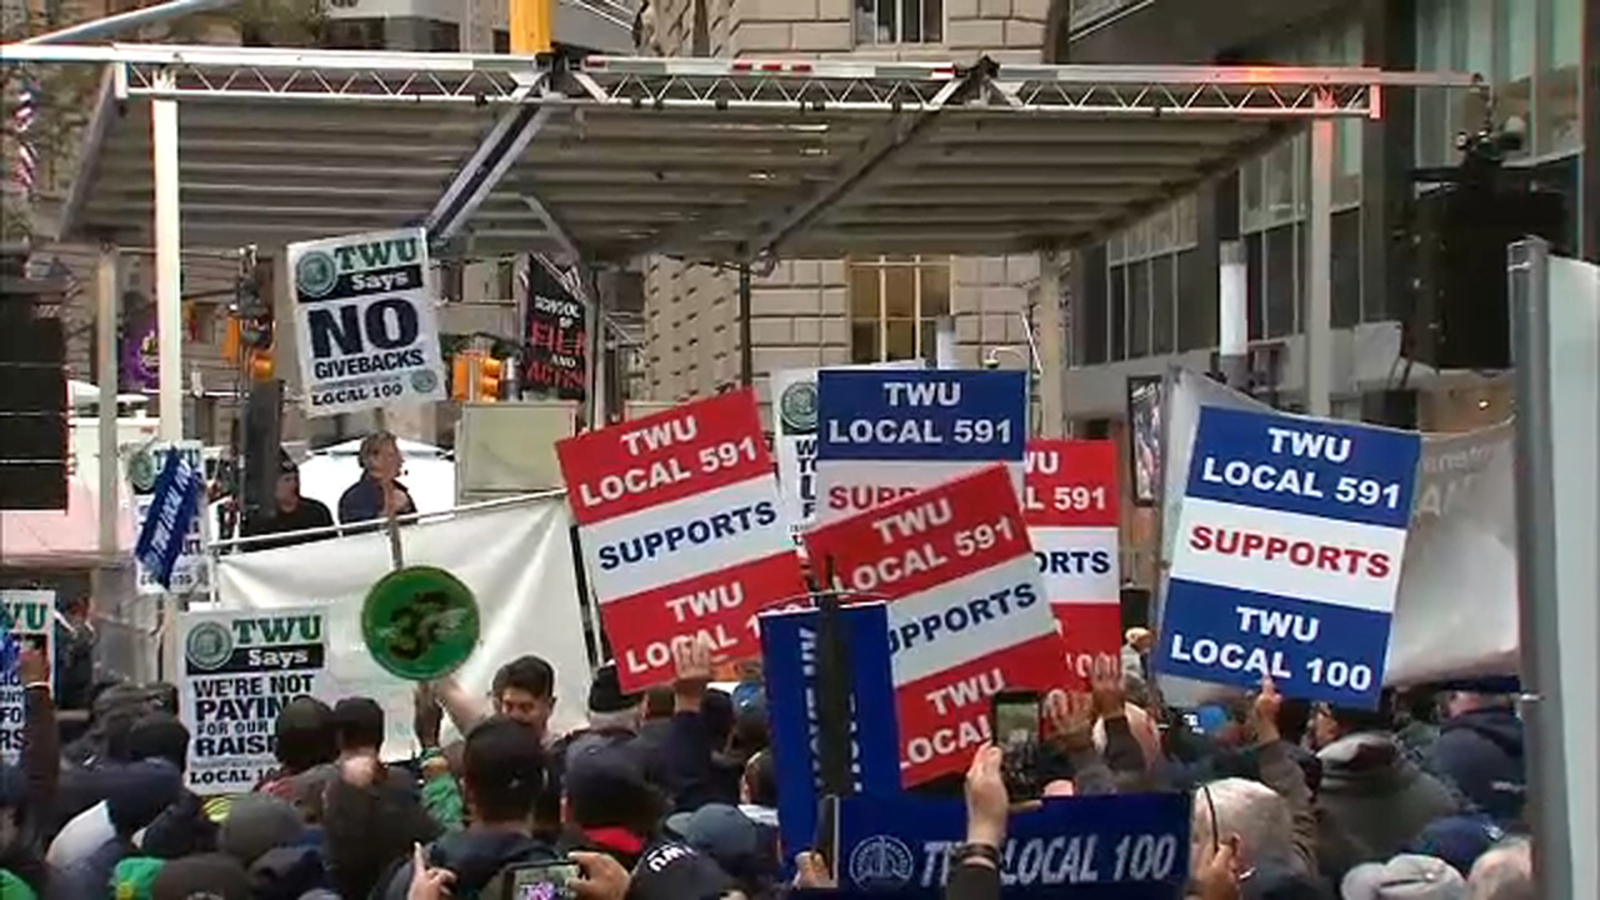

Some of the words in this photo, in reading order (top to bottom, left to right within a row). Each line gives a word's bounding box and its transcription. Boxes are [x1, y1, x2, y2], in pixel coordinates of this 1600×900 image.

[334, 238, 417, 271] TWU
[351, 270, 409, 292] Says
[307, 298, 419, 357] NO
[314, 349, 424, 380] GIVEBACKS
[551, 354, 576, 368] AND
[311, 388, 368, 406] LOCAL
[373, 383, 403, 398] 100
[882, 381, 962, 407] TWU
[619, 415, 698, 458] TWU
[828, 419, 943, 444] LOCAL
[953, 419, 1012, 444] 591
[1267, 427, 1352, 463] TWU
[578, 458, 693, 508] LOCAL
[699, 436, 758, 474] 591
[1202, 456, 1324, 499] LOCAL
[1335, 477, 1401, 510] 591
[1053, 486, 1108, 511] 591
[597, 500, 778, 572] SUPPORTS
[872, 498, 955, 545] TWU
[954, 522, 1016, 557] 591
[1189, 526, 1391, 579] SUPPORTS
[665, 580, 745, 623] TWU
[888, 583, 1038, 652] UPPORTS
[232, 616, 322, 644] TWU
[1235, 606, 1320, 643] TWU
[248, 650, 308, 671] Says
[1170, 634, 1292, 679] LOCAL
[1305, 658, 1372, 692] 100
[193, 678, 264, 698] WE'RE
[269, 674, 315, 693] NOT
[925, 667, 1007, 717] TWU
[195, 694, 310, 721] PAYIN
[196, 721, 229, 736] FOR
[234, 721, 269, 734] OUR
[190, 769, 252, 785] LOCAL
[998, 835, 1098, 886] LOCAL
[1112, 833, 1177, 880] 100
